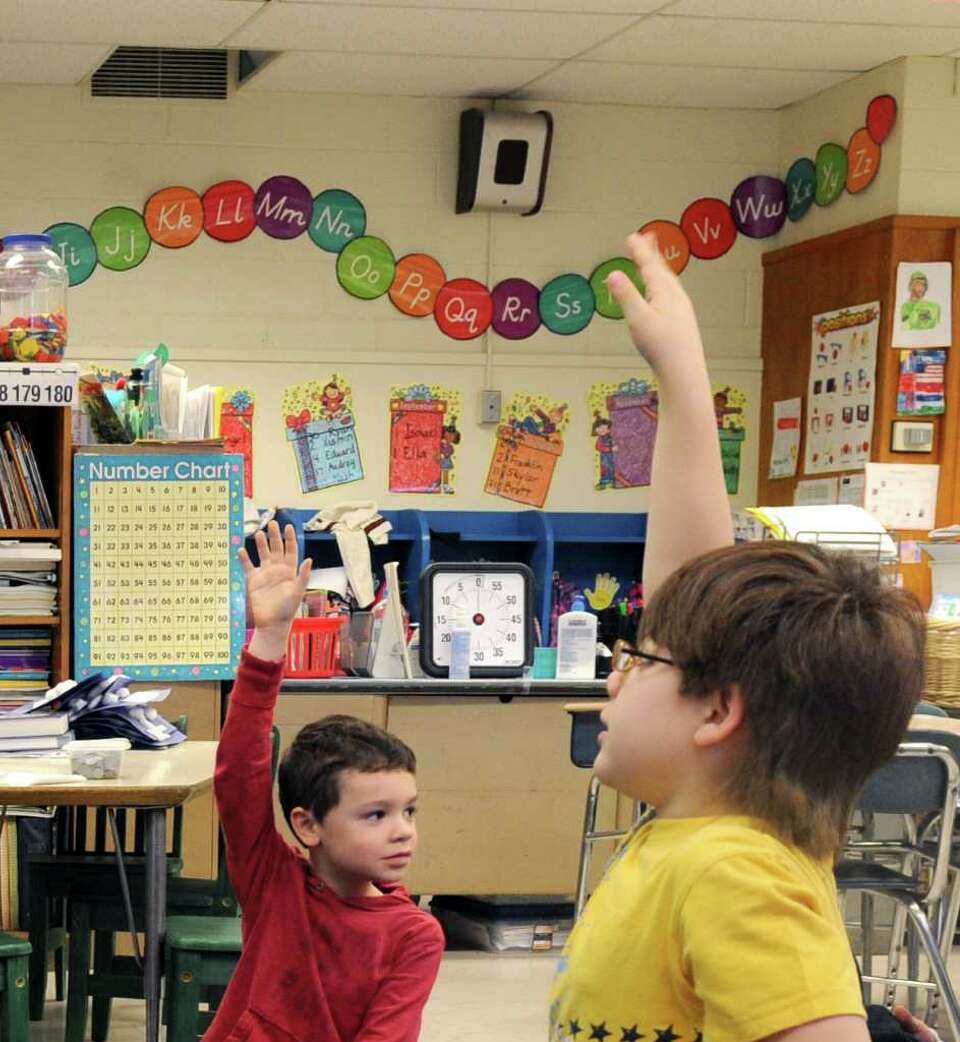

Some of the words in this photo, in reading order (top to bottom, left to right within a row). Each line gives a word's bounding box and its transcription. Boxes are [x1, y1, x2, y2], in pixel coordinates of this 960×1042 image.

[853, 148, 872, 180] Zz
[822, 162, 837, 197] Yy
[790, 179, 812, 209] Xx
[157, 206, 192, 231] Kk
[216, 197, 244, 226] Ll
[256, 192, 306, 226] Mm
[735, 194, 783, 224] Ww
[315, 206, 352, 238] Nn
[692, 217, 721, 245] Vv
[105, 226, 136, 262] Jj
[350, 254, 380, 284] Oo
[399, 273, 430, 309] Pp
[444, 297, 477, 333] Qq
[501, 296, 531, 323] Rr
[555, 292, 581, 319] Ss
[12, 384, 40, 402] 179
[45, 384, 73, 403] 180
[90, 462, 169, 479] Number
[175, 461, 231, 479] Chart
[150, 486, 156, 494] 5
[93, 505, 100, 513] 11
[162, 504, 171, 513] 16
[190, 504, 198, 512] 18
[204, 504, 212, 512] 19
[93, 524, 101, 532] 21
[106, 524, 116, 532] 22
[148, 523, 158, 531] 25
[176, 523, 185, 531] 27
[190, 523, 199, 531] 28
[204, 522, 214, 531] 29
[217, 522, 227, 530] 30
[458, 583, 464, 591] 5
[475, 578, 482, 587] 0
[491, 581, 502, 591] 55
[441, 596, 450, 606] 10
[506, 595, 517, 605] 50
[437, 615, 447, 624] 15
[511, 615, 522, 624] 45
[441, 633, 452, 642] 20
[506, 632, 517, 642] 40
[473, 652, 484, 662] 30
[492, 647, 504, 657] 35
